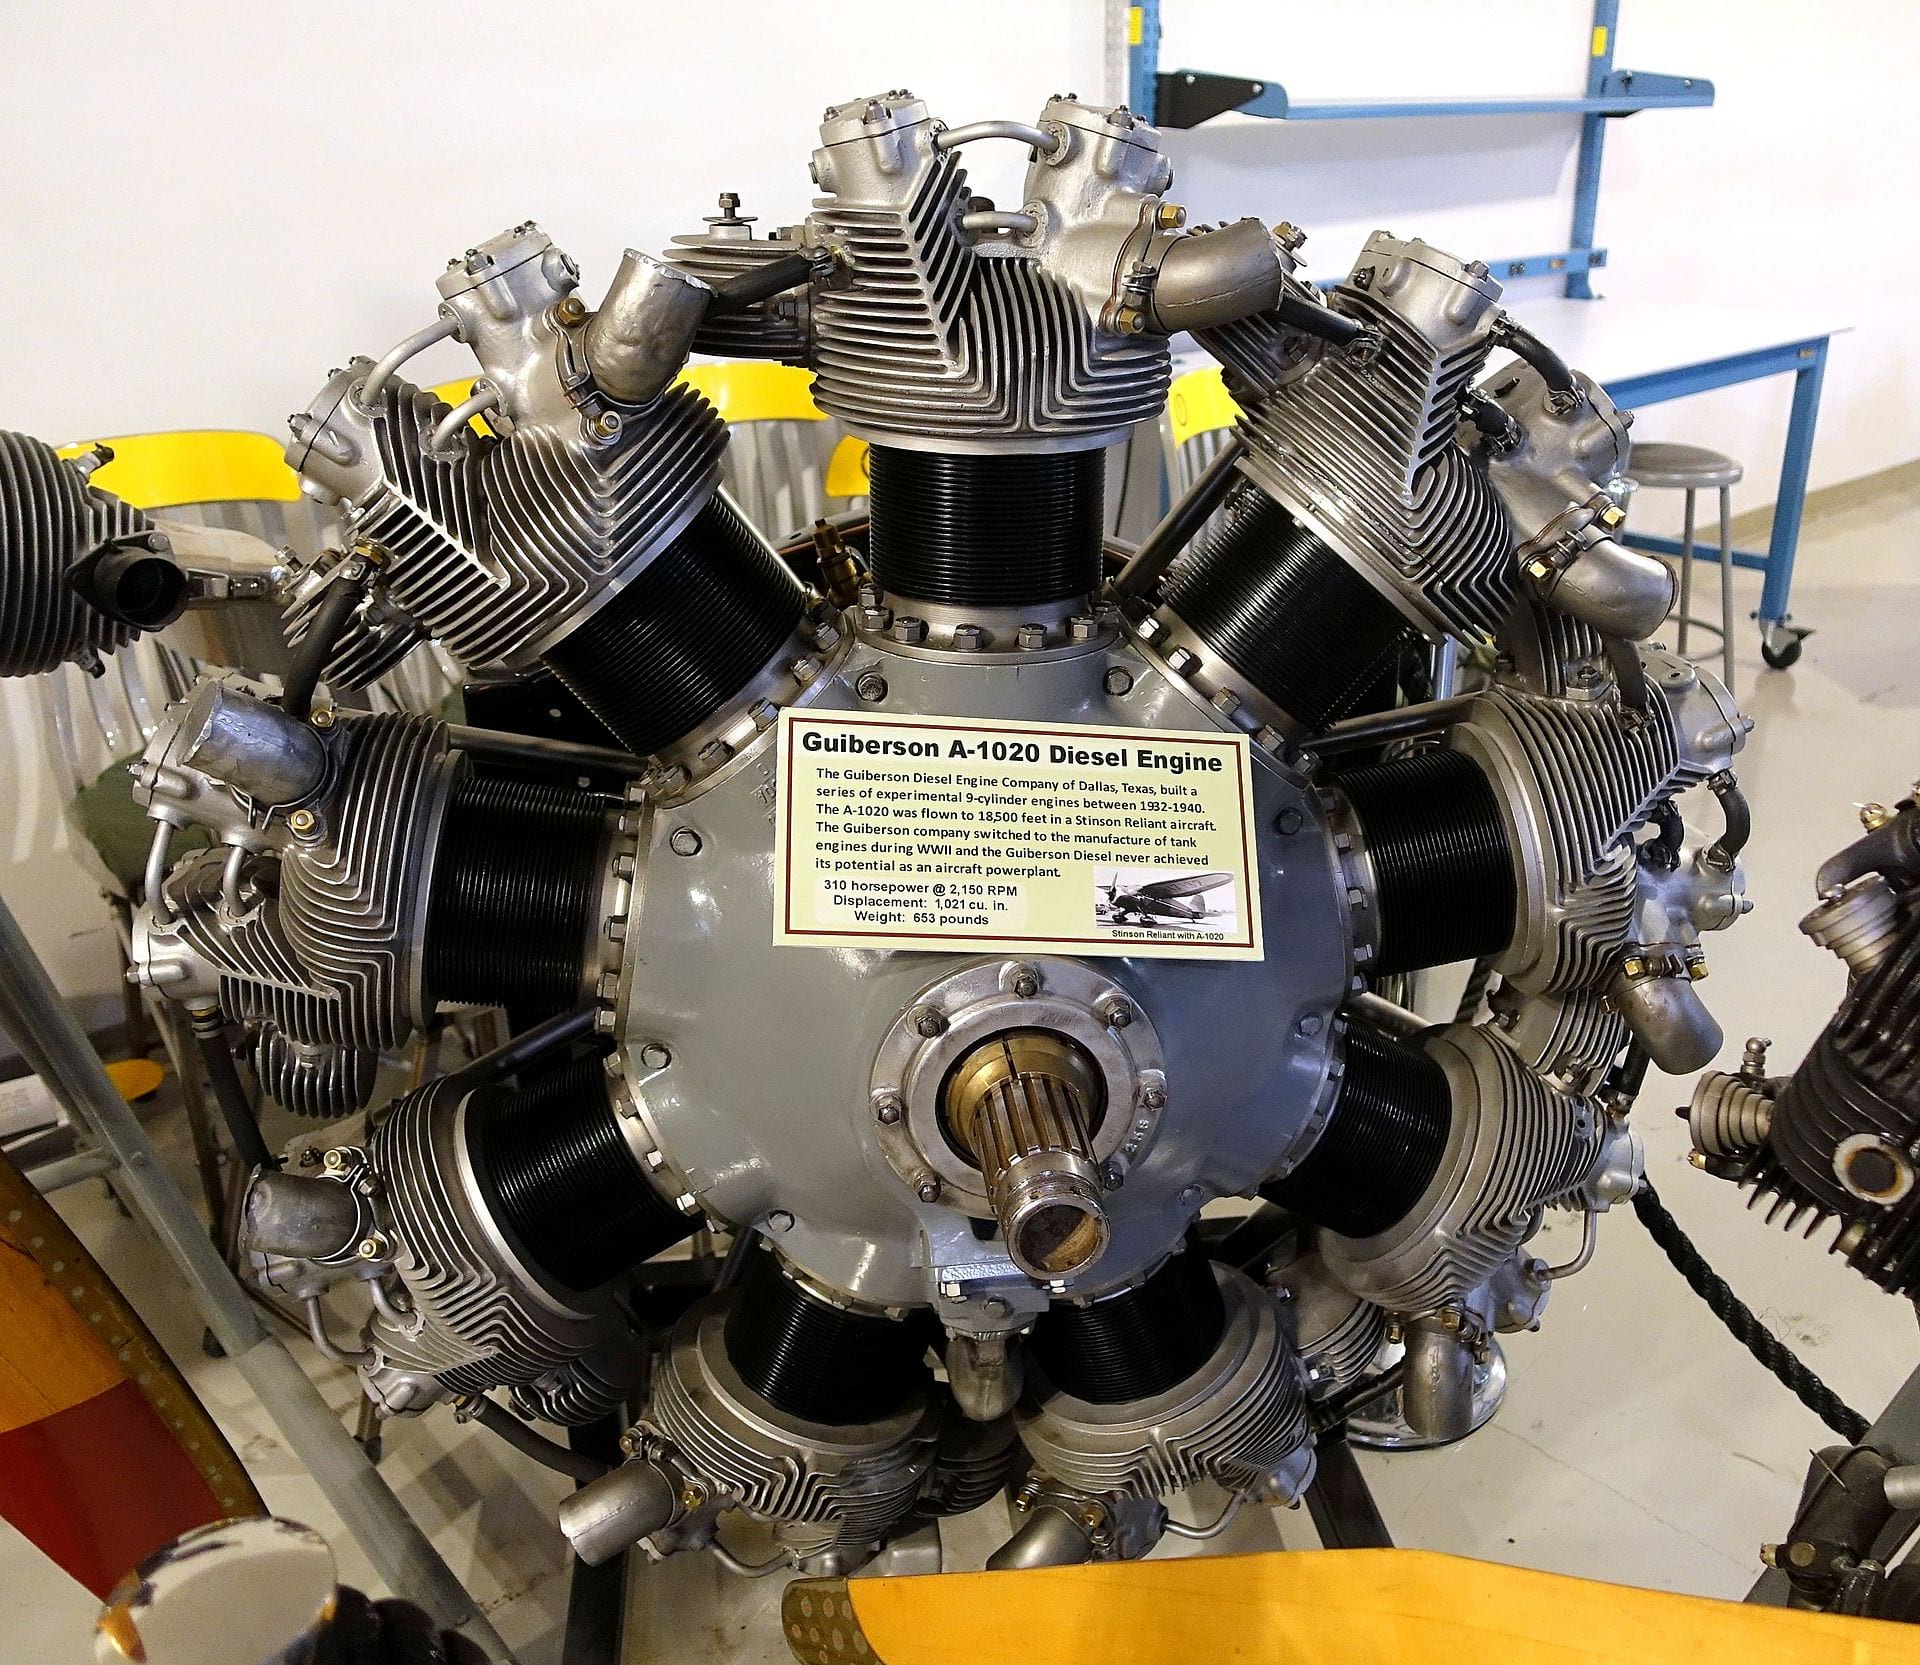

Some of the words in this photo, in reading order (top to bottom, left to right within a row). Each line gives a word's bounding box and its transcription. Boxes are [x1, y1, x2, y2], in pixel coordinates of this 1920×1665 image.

[802, 732, 939, 757] Guiberson
[947, 740, 1039, 762] A-1020
[1049, 745, 1127, 766] Diesel
[1137, 750, 1222, 774] Engine
[815, 767, 840, 780] The
[843, 769, 910, 783] Guiberson
[913, 772, 952, 785] Diesel
[956, 774, 998, 789] Engine
[1001, 776, 1059, 792] Company
[1062, 779, 1076, 791] of
[1078, 780, 1119, 795] Dallas,
[1121, 782, 1157, 797] Texas,
[1160, 783, 1188, 796] built
[1190, 788, 1198, 797] a
[816, 786, 856, 798] series
[858, 787, 873, 799] of
[876, 789, 962, 803] experimental
[965, 792, 1028, 807] 9-cylinder
[1030, 796, 1080, 809] engines
[1083, 797, 1137, 811] between
[1140, 800, 1205, 814] 1932-1940.
[815, 803, 840, 815] The
[843, 804, 889, 817] A-1020
[892, 809, 918, 819] was
[921, 807, 958, 820] flown
[960, 810, 975, 821] to
[978, 810, 1018, 824] 18,500
[1021, 812, 1048, 824] feet
[1050, 813, 1062, 825] in
[1065, 816, 1073, 825] a
[1075, 814, 1122, 827] Stinson
[1124, 817, 1168, 830] Reliant
[1170, 819, 1217, 832] aircraft.
[815, 821, 840, 833] The
[843, 822, 910, 836] Guiberson
[913, 827, 971, 841] company
[973, 828, 1031, 841] switched
[1033, 831, 1047, 842] to
[1050, 831, 1071, 843] the
[1074, 833, 1151, 846] manufacture
[1154, 835, 1168, 847] of
[1170, 836, 1197, 848] tank
[815, 840, 868, 854] engines
[870, 841, 914, 857] during
[916, 843, 952, 856] WWII
[955, 845, 979, 857] and
[981, 845, 1002, 858] the
[1005, 847, 1071, 860] Guiberson
[1073, 849, 1112, 862] Diesel
[1115, 854, 1151, 864] never
[1153, 853, 1209, 866] achieved
[815, 857, 831, 869] its
[834, 859, 895, 872] potential
[899, 863, 913, 872] as
[916, 863, 932, 873] an
[935, 862, 983, 875] aircraft
[985, 865, 1061, 879] powerplant.
[824, 879, 847, 891] 310
[851, 880, 930, 895] horsepower
[932, 883, 946, 897] @
[949, 883, 984, 897] 2,150
[987, 885, 1018, 897] RPM
[833, 894, 927, 909] Displacement:
[934, 898, 965, 911] 1,021
[968, 901, 988, 911] cu.
[993, 899, 1008, 911] in.
[853, 910, 905, 925] Weight:
[913, 912, 936, 924] 653
[939, 914, 989, 927] pounds
[1111, 929, 1145, 938] Stinson
[1146, 930, 1176, 939] Reliant
[1176, 931, 1195, 940] with
[1196, 932, 1224, 941] A-1020
